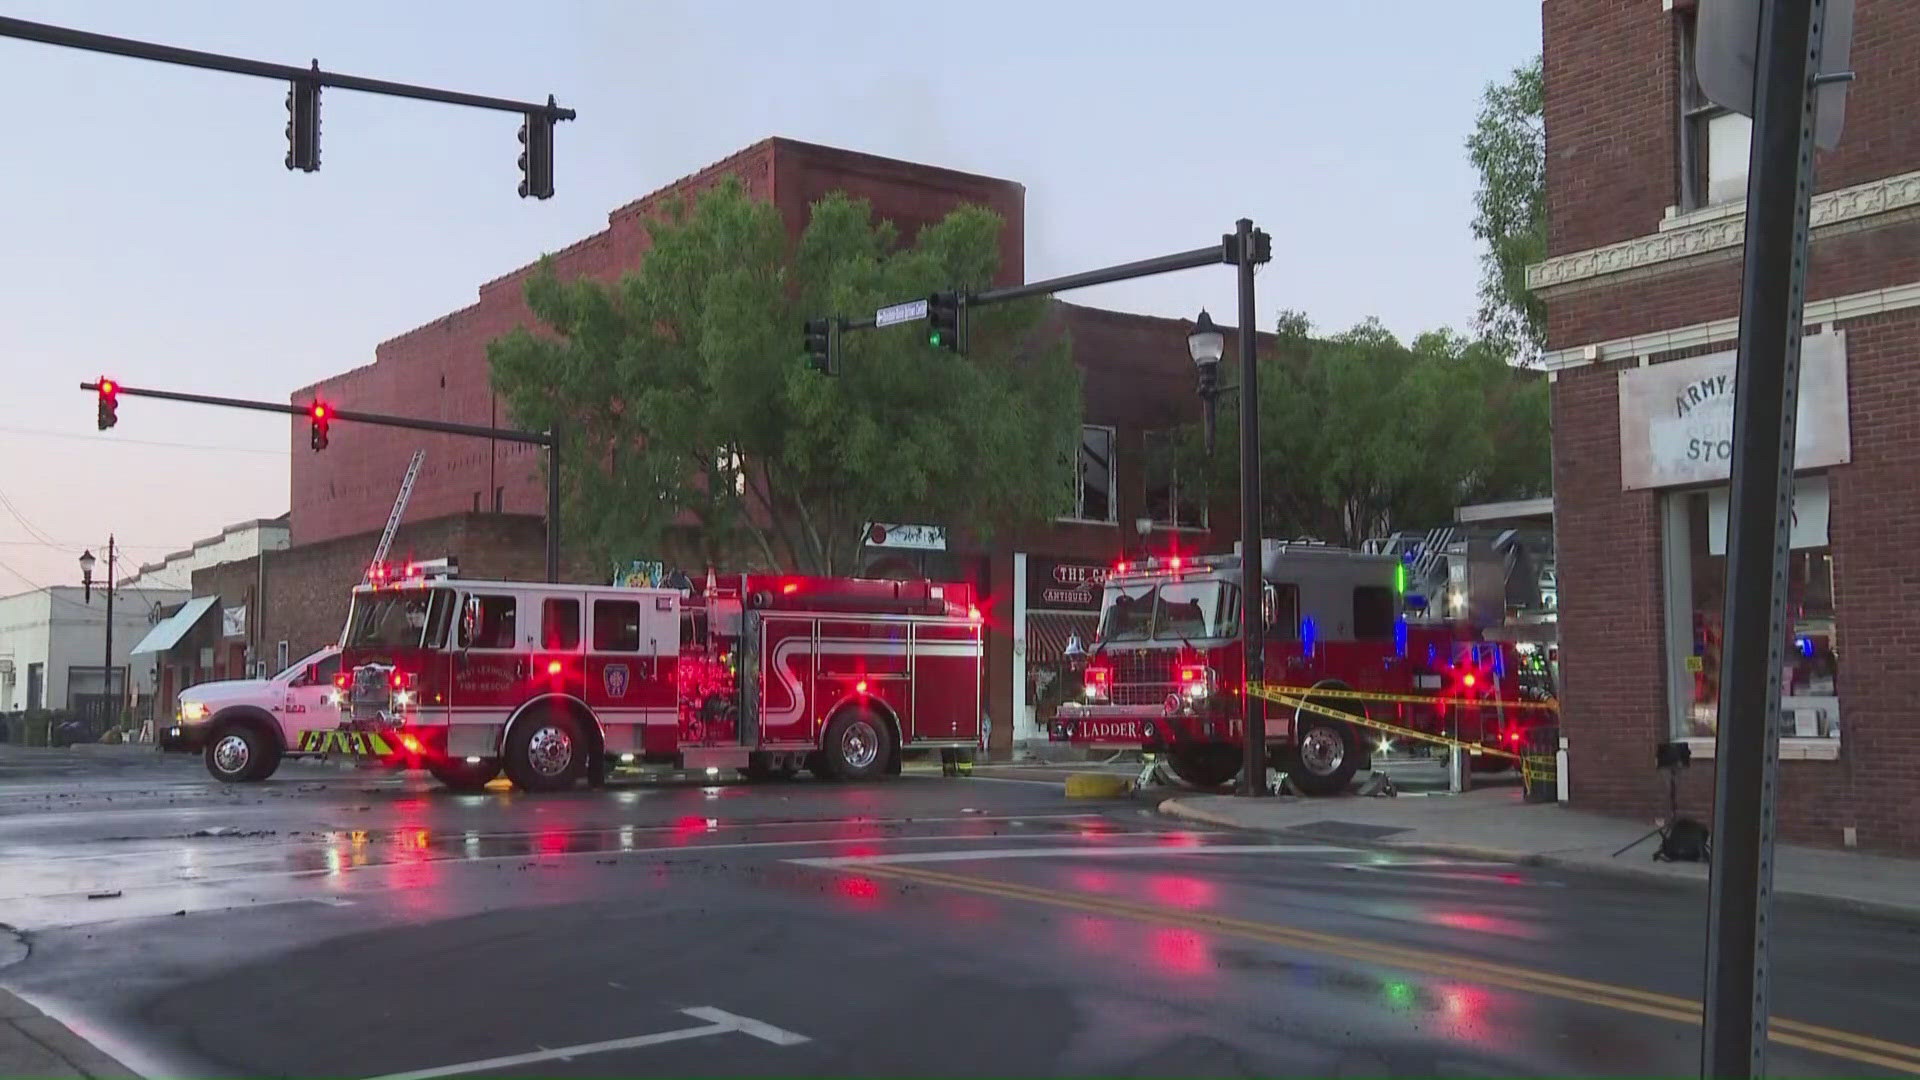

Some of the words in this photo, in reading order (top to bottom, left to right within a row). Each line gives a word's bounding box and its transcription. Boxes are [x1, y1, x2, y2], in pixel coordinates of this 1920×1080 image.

[1676, 375, 1727, 419] ARMY
[1687, 438, 1731, 462] STO
[1060, 567, 1084, 581] THE
[1047, 591, 1088, 602] ANTIQUES
[1083, 721, 1137, 738] LADDER
